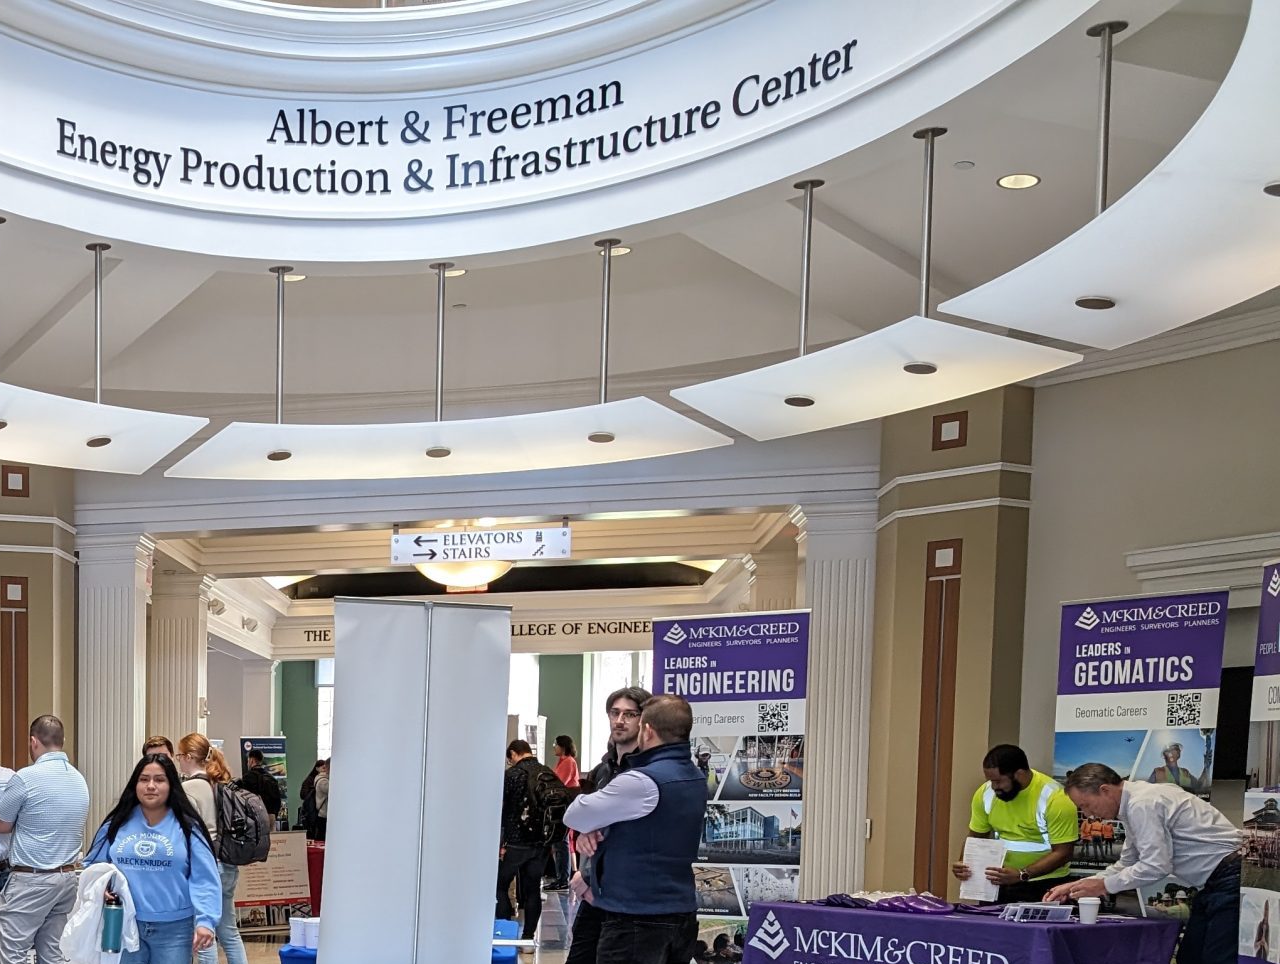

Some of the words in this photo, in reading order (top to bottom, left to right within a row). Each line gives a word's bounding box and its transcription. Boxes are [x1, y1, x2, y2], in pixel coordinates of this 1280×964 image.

[56, 117, 172, 189] Energy
[179, 152, 393, 196] Production
[402, 157, 435, 193] &
[445, 94, 722, 191] Infrastructure
[732, 37, 860, 119] Center
[267, 106, 389, 148] Albert
[400, 110, 432, 146] &
[442, 78, 625, 142] Freeman
[443, 531, 524, 547] ELEVATORS
[442, 546, 491, 560] STAIRS
[303, 630, 331, 642] THE
[511, 623, 557, 636] LLEGE
[561, 622, 583, 635] OF
[587, 620, 654, 634] ENGINEE
[1100, 624, 1136, 634] ENGINEERS
[1140, 621, 1179, 631] SURVEYORS
[1184, 618, 1220, 628] PLANNERS
[688, 640, 722, 648] ENGINEERS
[726, 638, 762, 647] SURVEYORS
[766, 637, 799, 645] PLANNERS
[1076, 642, 1121, 658] LEADERS
[1124, 646, 1131, 655] IN
[1259, 642, 1277, 655] PEOPLE
[664, 656, 708, 670] LEADERS
[710, 660, 717, 668] IN
[1073, 655, 1194, 687] GEOMATICS
[663, 668, 796, 696] ENGINEERING
[713, 712, 745, 724] Careers
[1075, 706, 1115, 719] Geomatic
[1116, 706, 1148, 718] Careers
